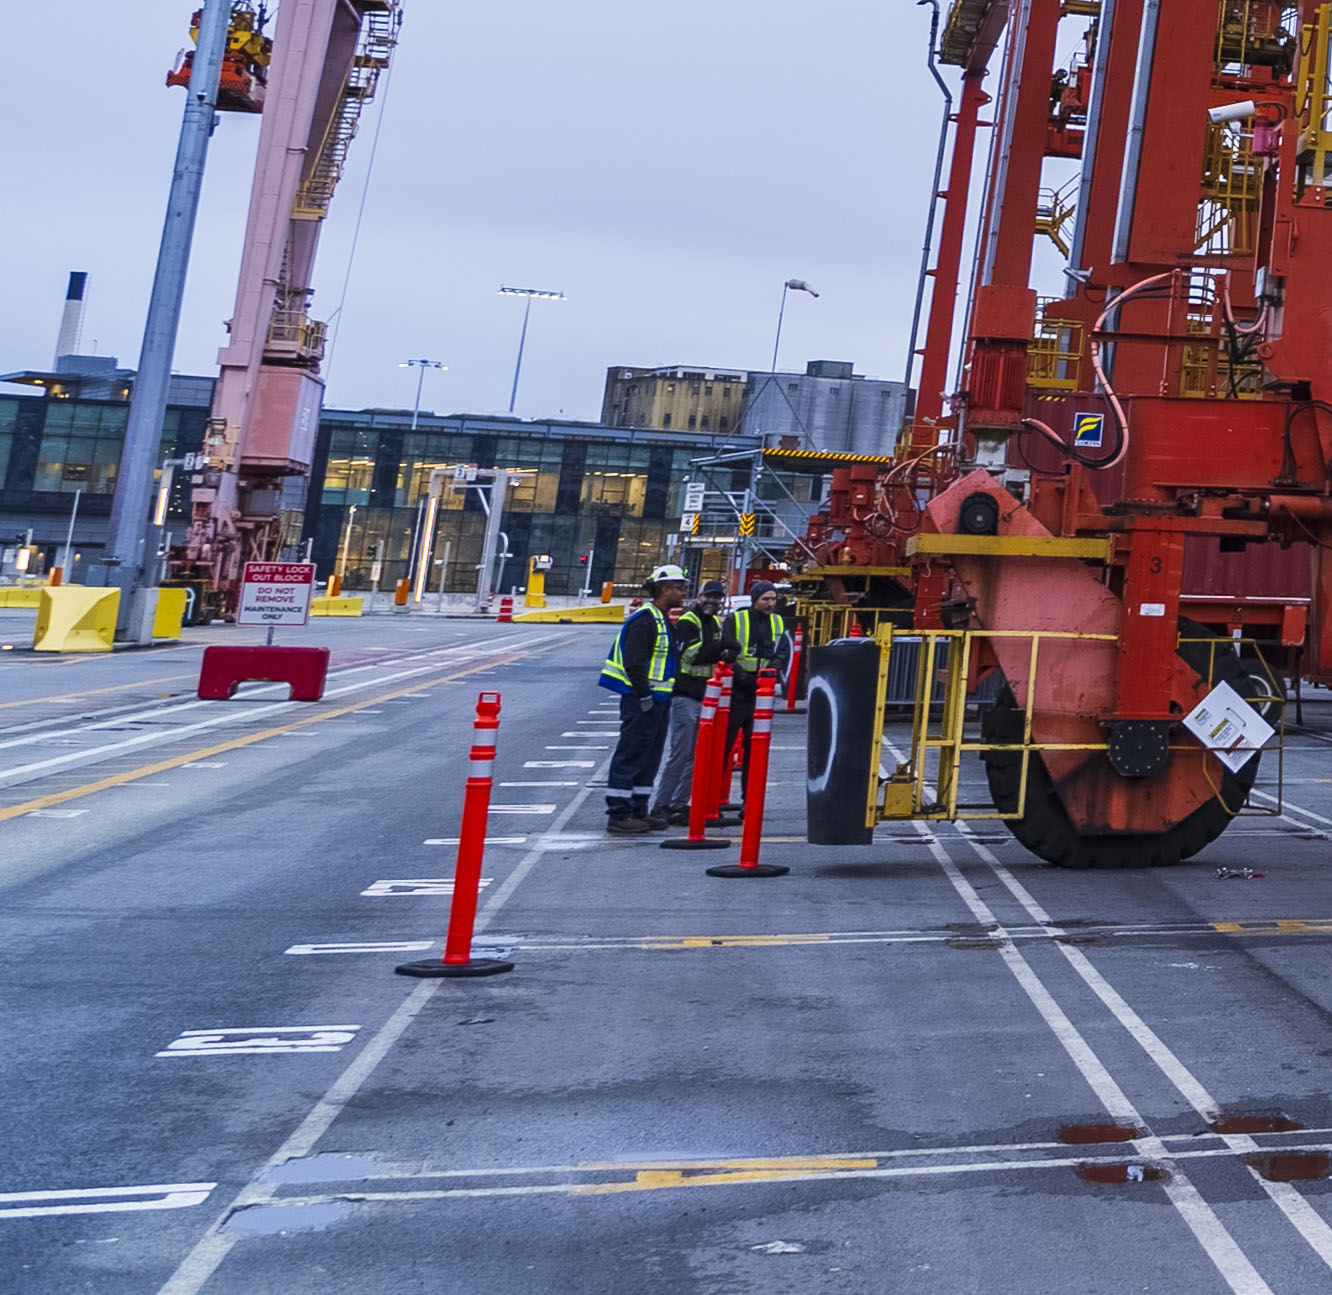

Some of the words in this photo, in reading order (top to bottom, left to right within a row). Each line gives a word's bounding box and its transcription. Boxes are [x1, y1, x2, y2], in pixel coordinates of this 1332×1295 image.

[1150, 556, 1162, 574] 3
[248, 565, 283, 573] SAFETY
[286, 566, 311, 574] LOCK
[252, 573, 271, 582] OUT
[273, 574, 305, 582] BLOCK
[275, 587, 295, 595] NOT
[255, 595, 295, 603] REMOVE
[244, 605, 303, 613] MAINTENANCE
